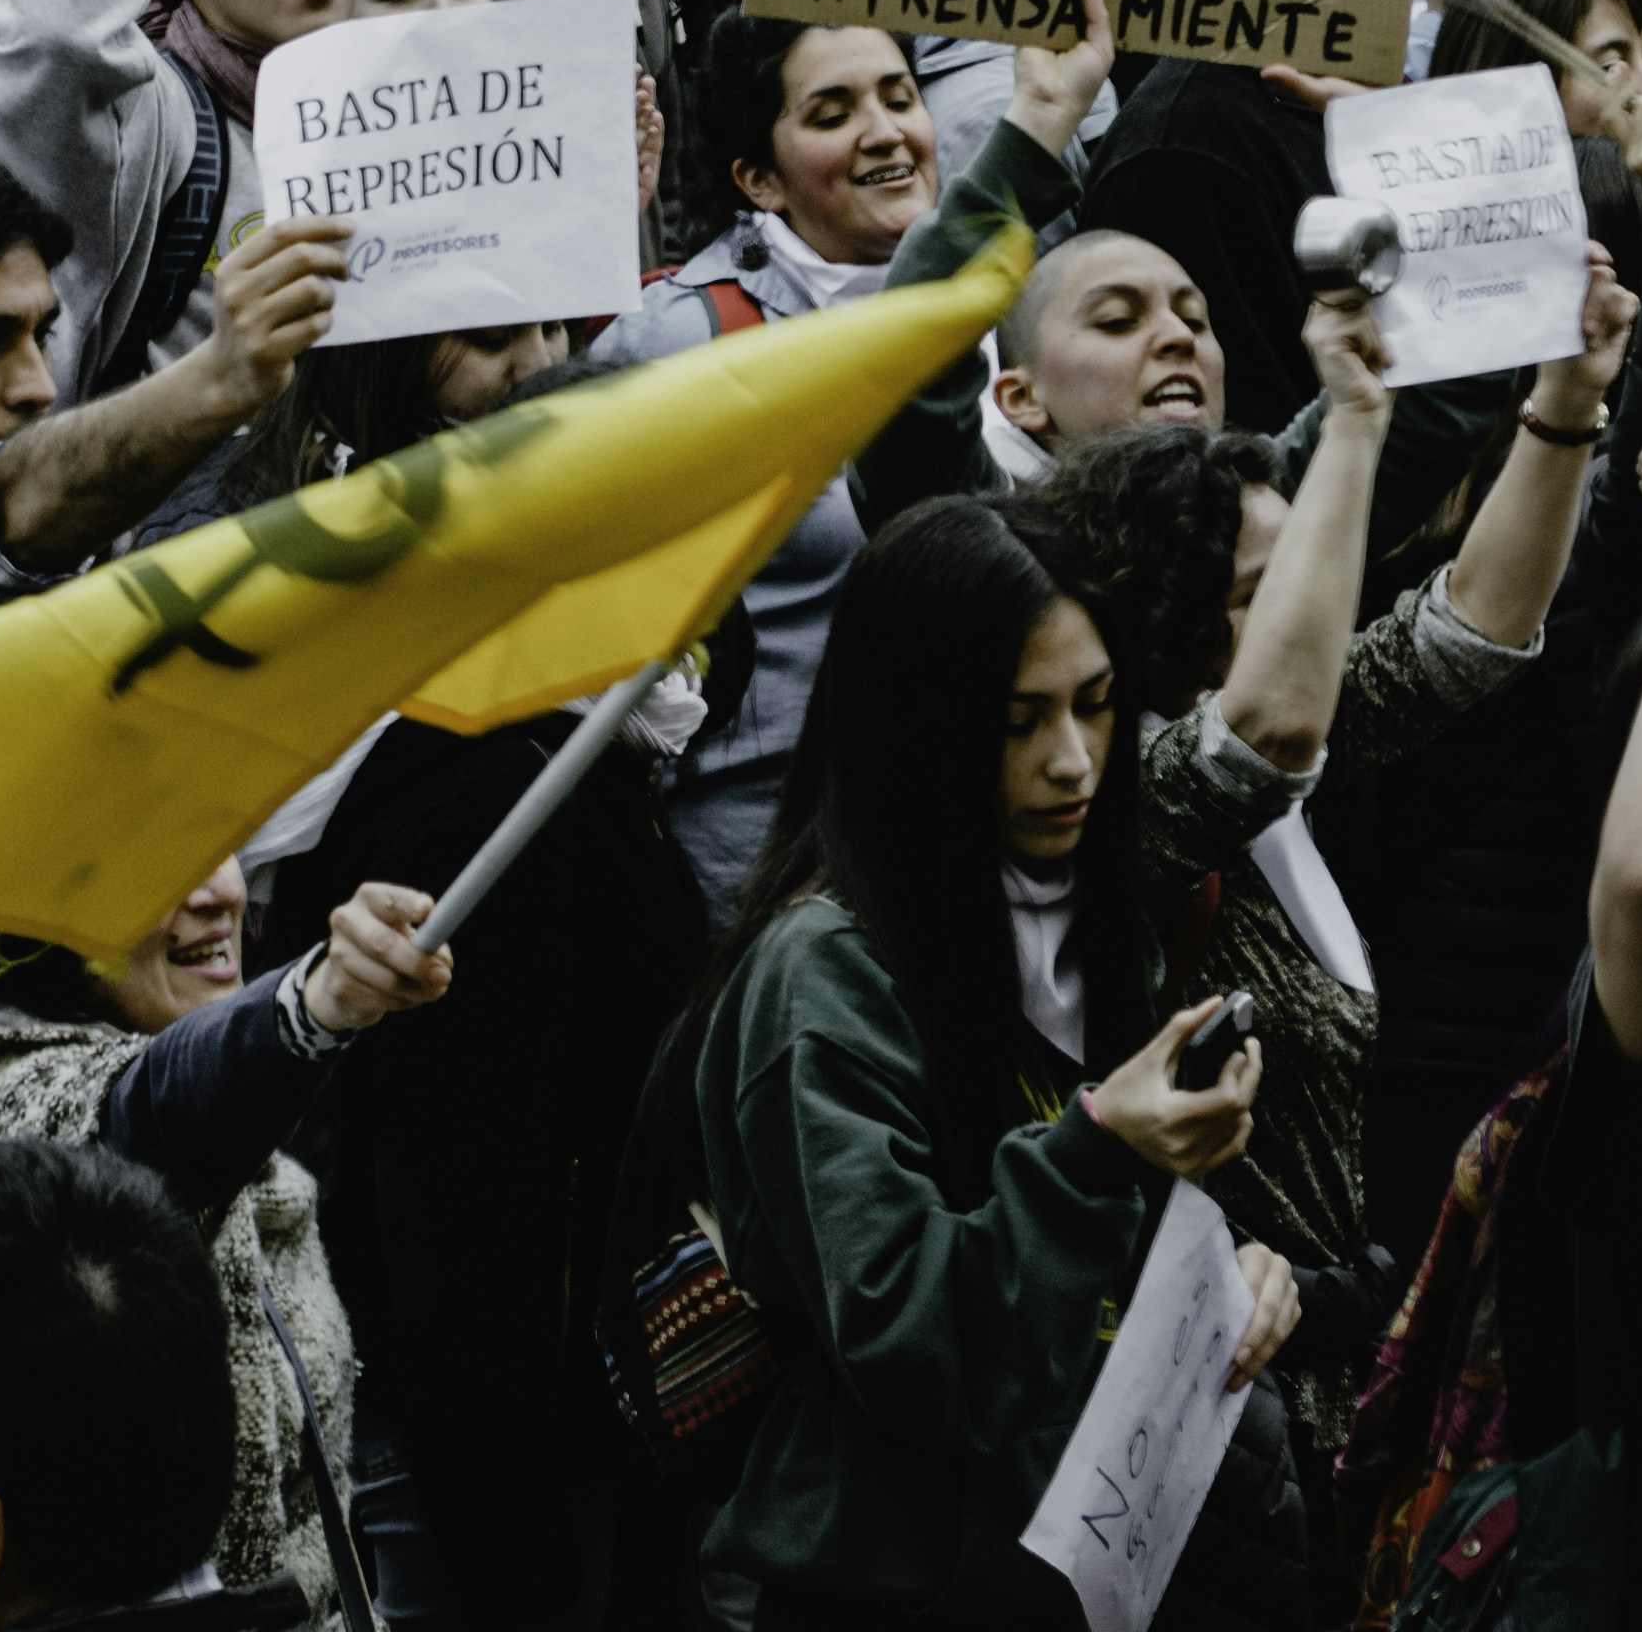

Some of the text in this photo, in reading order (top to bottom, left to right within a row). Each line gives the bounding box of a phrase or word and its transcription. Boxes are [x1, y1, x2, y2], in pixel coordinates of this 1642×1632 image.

[294, 63, 545, 144] BASTA DE
[283, 127, 566, 218] REPRESIÓN
[1369, 132, 1519, 190] BASTA
[392, 231, 502, 262] PROFESORES
[1403, 185, 1575, 254] EPRESIÓN
